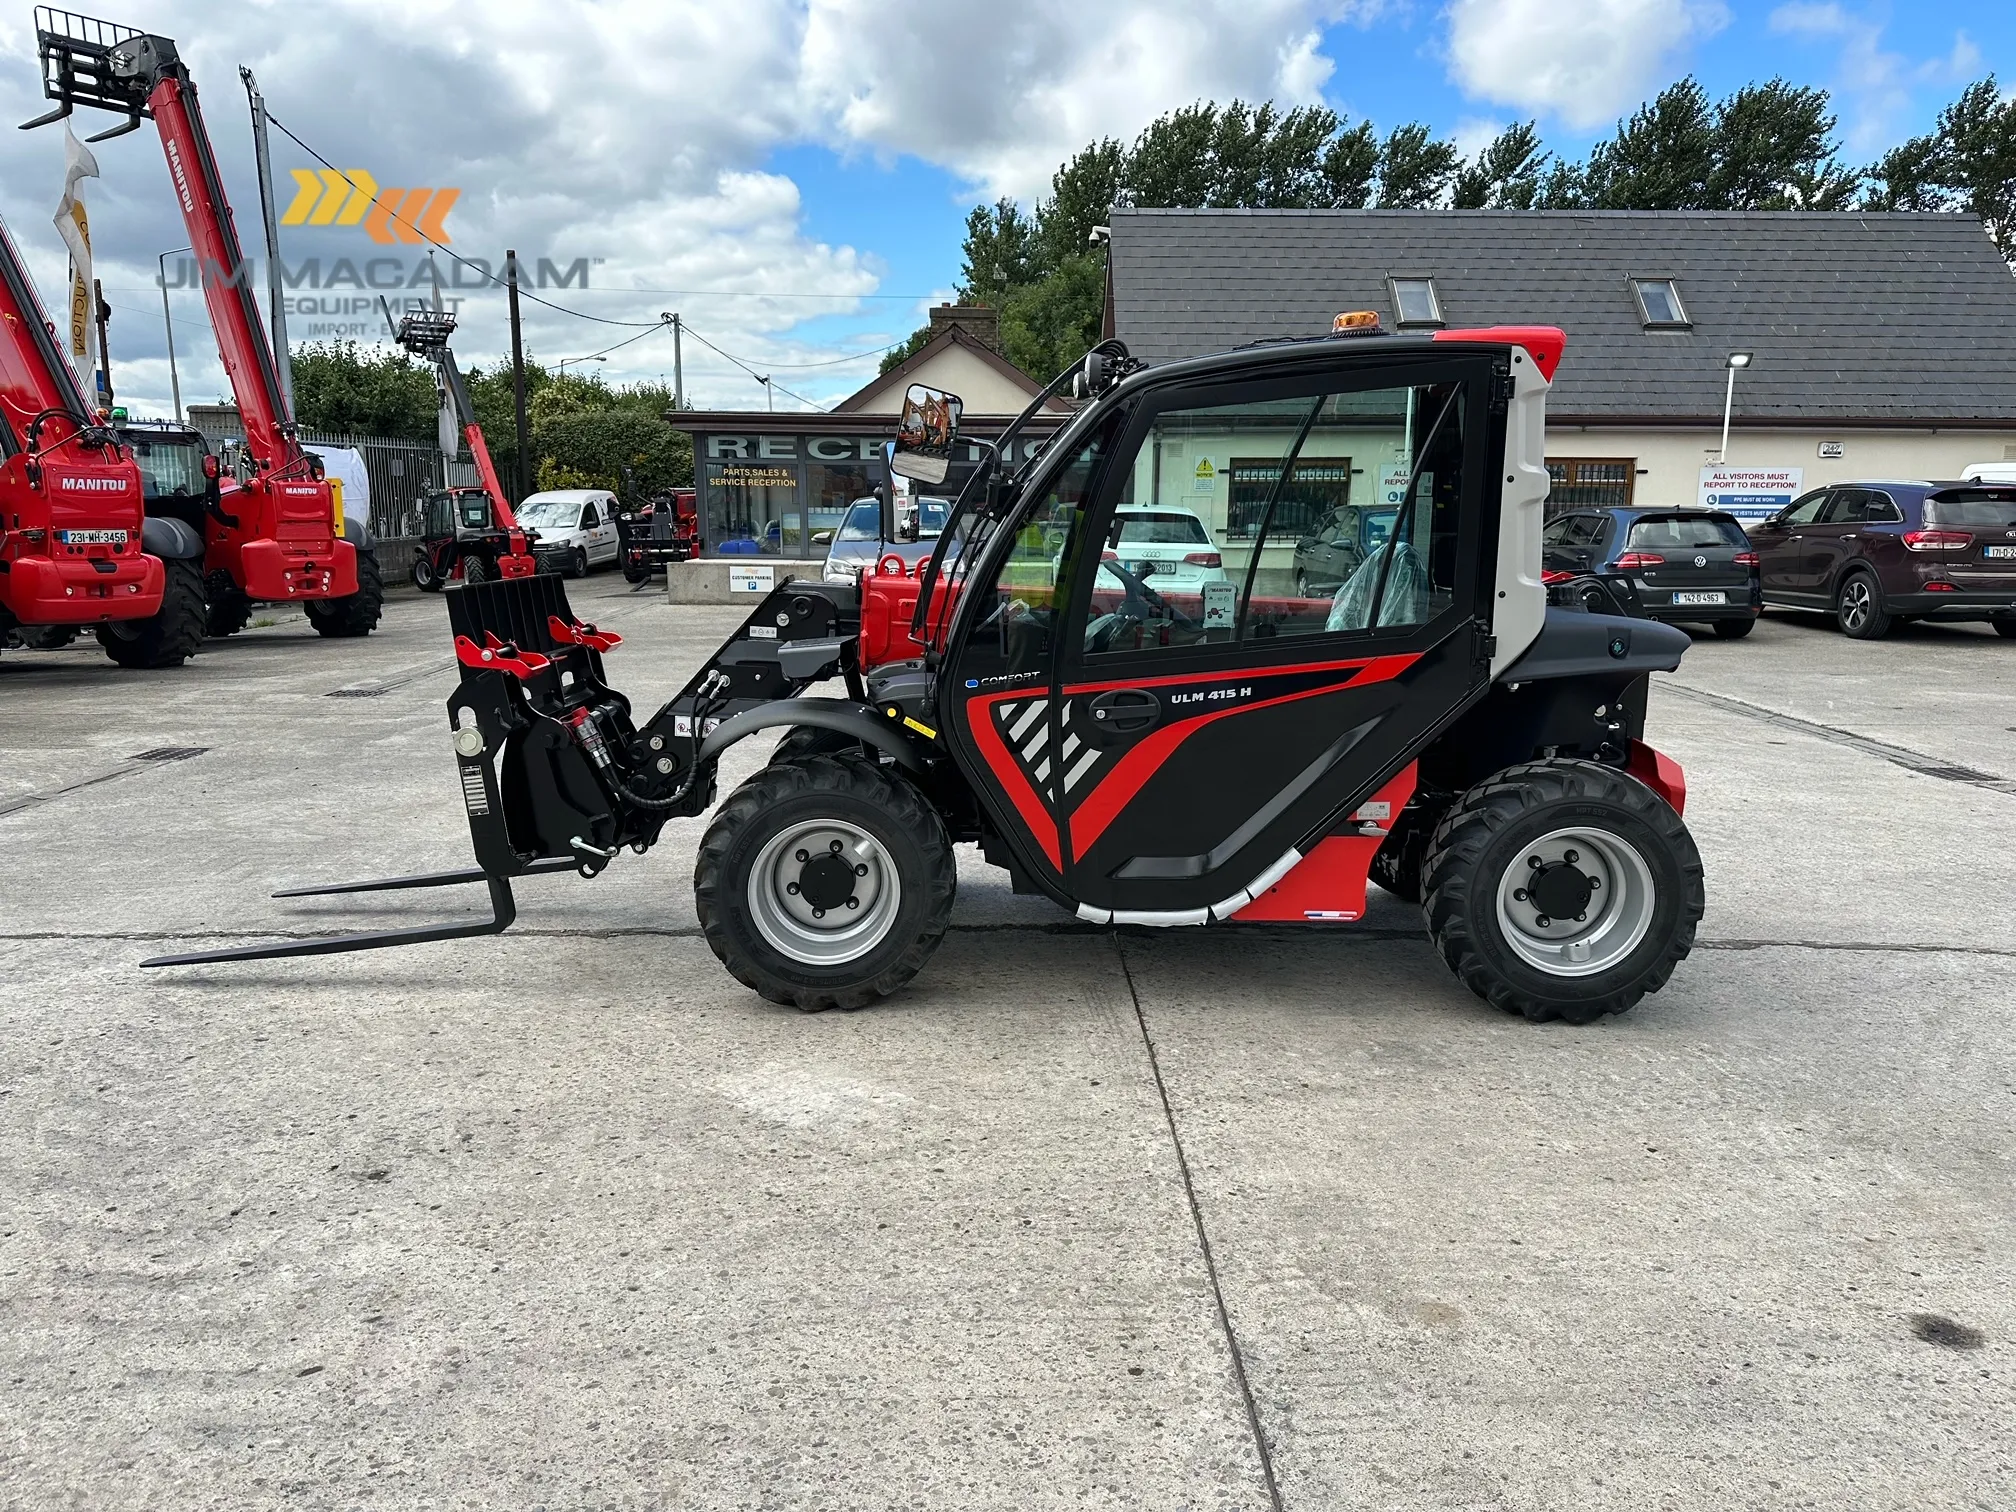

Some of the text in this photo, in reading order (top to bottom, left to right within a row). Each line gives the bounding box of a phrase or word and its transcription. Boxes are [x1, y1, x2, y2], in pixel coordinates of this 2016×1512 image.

[167, 139, 193, 213] MANITOU
[781, 469, 788, 477] &
[62, 478, 127, 491] MANITOU
[709, 478, 796, 487] SERVICE RECEPTION
[285, 487, 317, 495] MANITOU
[70, 531, 126, 543] 231-MH-3456
[981, 671, 1041, 686] COMFORT
[1171, 687, 1252, 704] ULM 415 H
